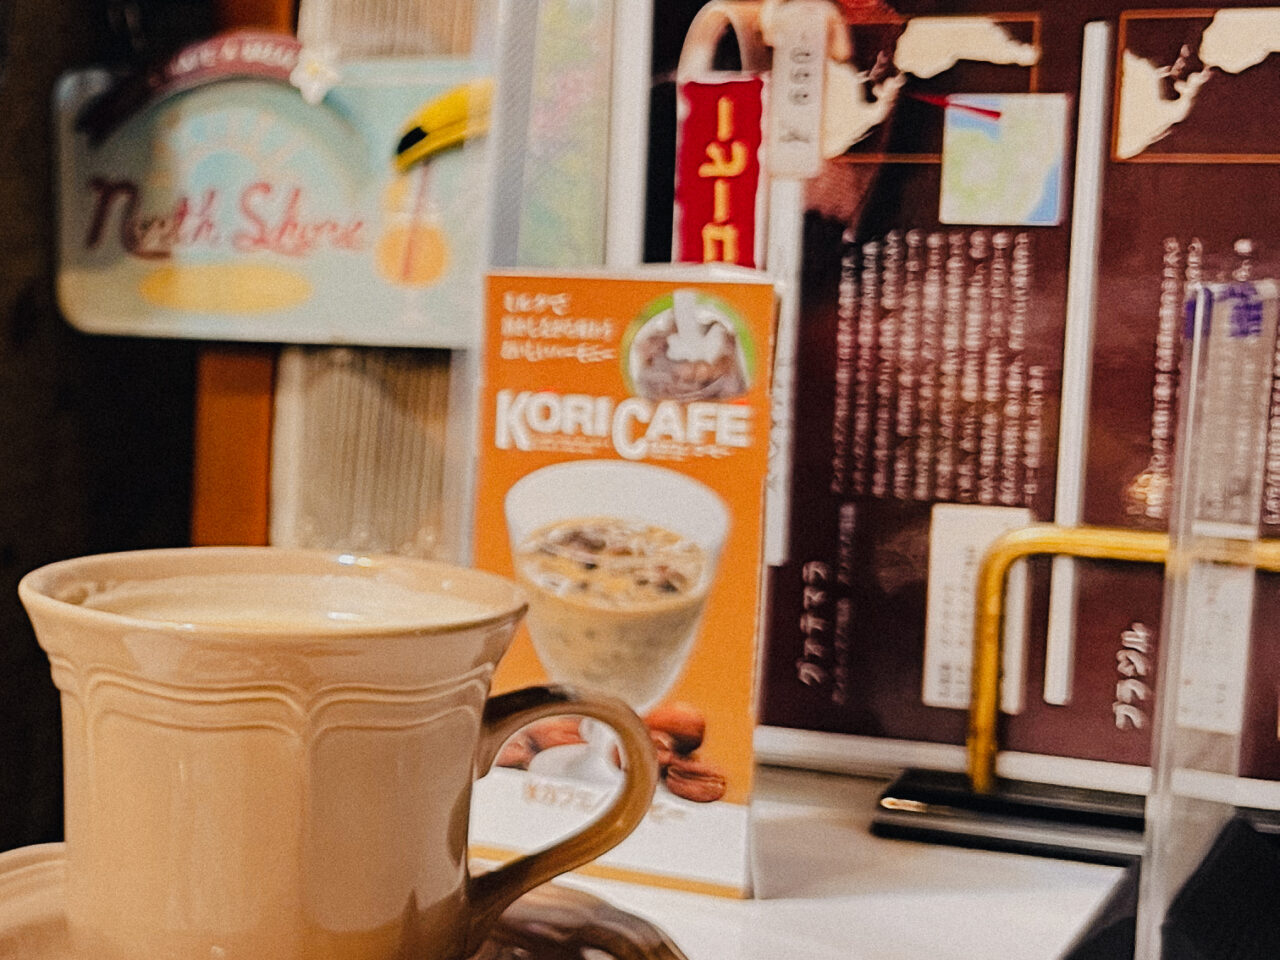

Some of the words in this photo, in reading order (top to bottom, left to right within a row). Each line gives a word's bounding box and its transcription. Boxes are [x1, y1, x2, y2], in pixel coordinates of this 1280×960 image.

[231, 181, 365, 257] Shore
[698, 96, 749, 264] コーヒー
